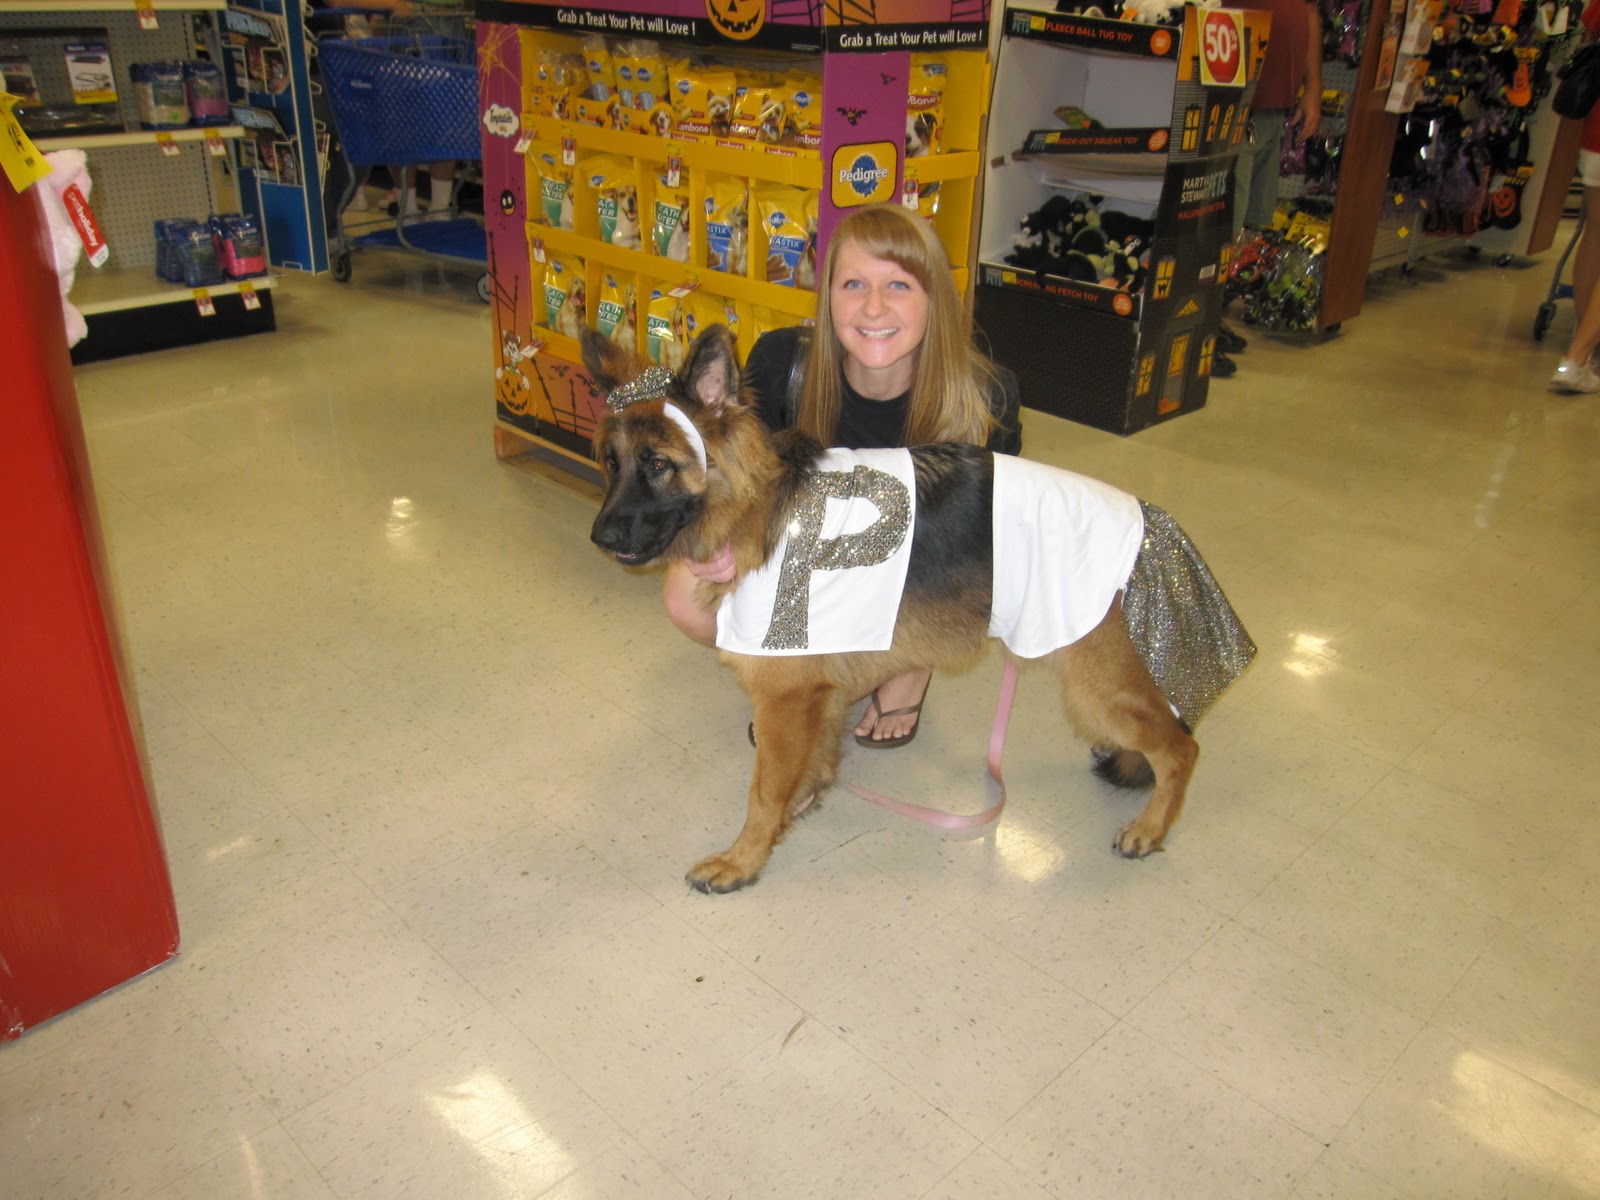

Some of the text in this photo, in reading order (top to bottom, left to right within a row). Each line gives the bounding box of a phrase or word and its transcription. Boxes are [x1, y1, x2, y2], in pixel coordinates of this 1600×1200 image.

[557, 9, 577, 24] Grab
[578, 14, 585, 24] a
[586, 12, 607, 27] Treat
[608, 14, 628, 29] Your
[630, 16, 645, 31] Pet
[647, 18, 664, 32] will
[665, 20, 689, 35] Love
[1012, 21, 1030, 34] PETS
[839, 33, 864, 47] Grab
[866, 36, 872, 46] a
[874, 32, 898, 46] Treat
[900, 31, 920, 45] Your
[922, 31, 937, 44] Pet
[939, 29, 955, 43] will
[956, 30, 977, 42] Love
[1046, 23, 1134, 42] FLEECE BALL TUG TOY
[1094, 137, 1122, 145] SQUEAK
[1123, 136, 1139, 144] TOY
[838, 167, 889, 183] Pedigree
[1015, 278, 1099, 302] SCREANG FETCH TOY
[761, 463, 914, 651] P
